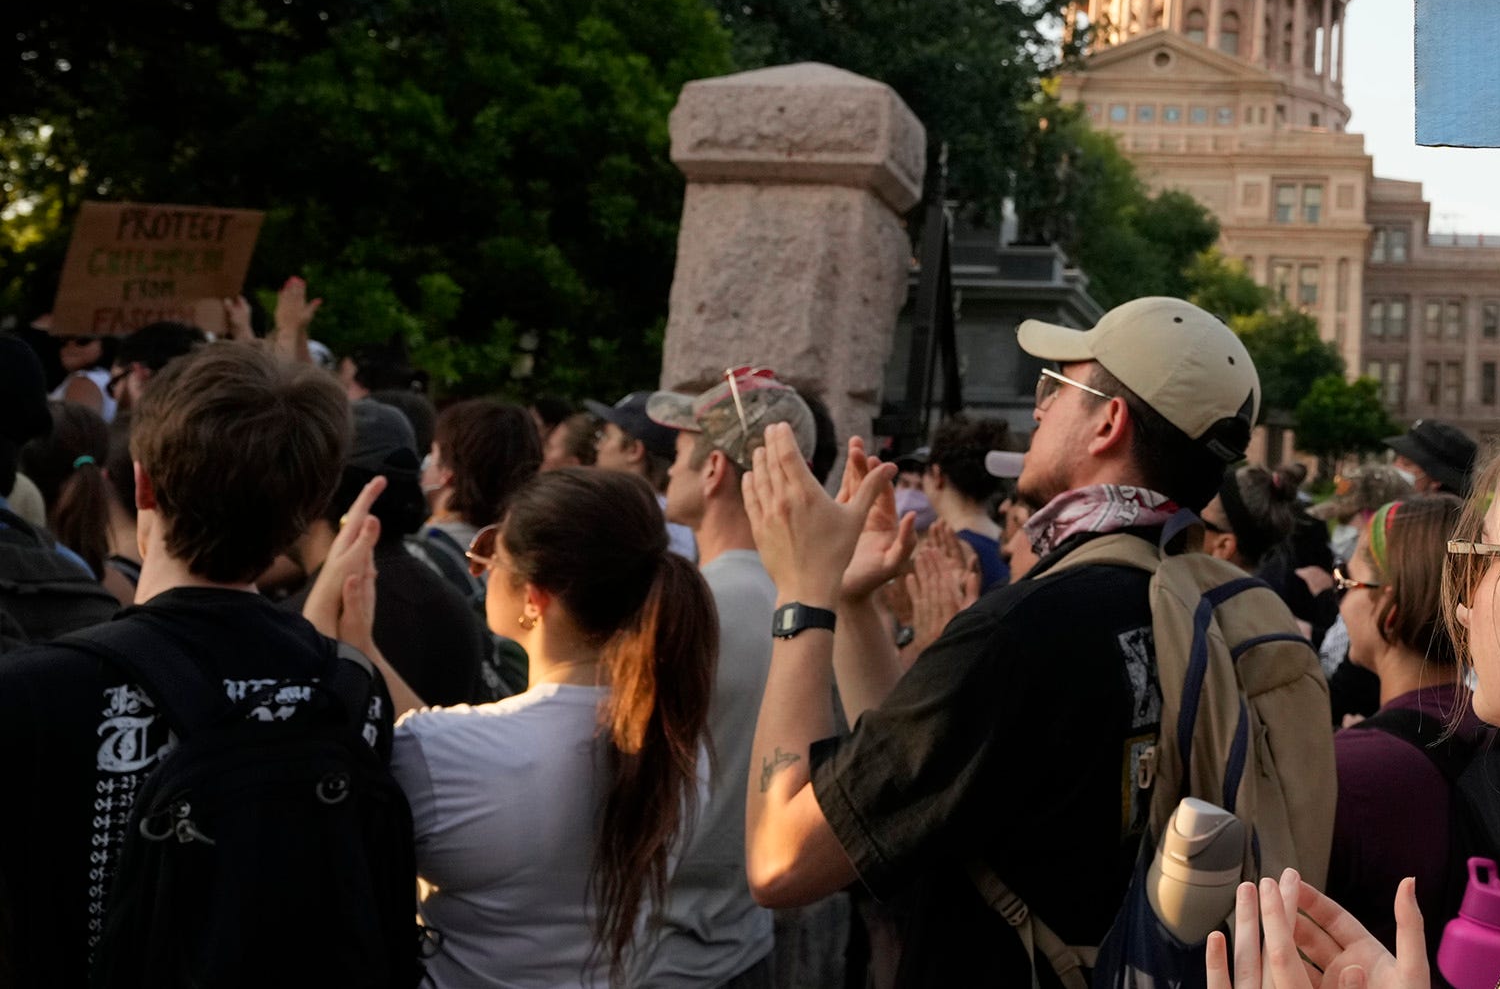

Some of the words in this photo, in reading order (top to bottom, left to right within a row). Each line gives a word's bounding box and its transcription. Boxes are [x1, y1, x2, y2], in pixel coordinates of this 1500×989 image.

[116, 209, 233, 241] PROTECT
[87, 247, 224, 275] CHILDREN
[123, 278, 176, 300] FROM
